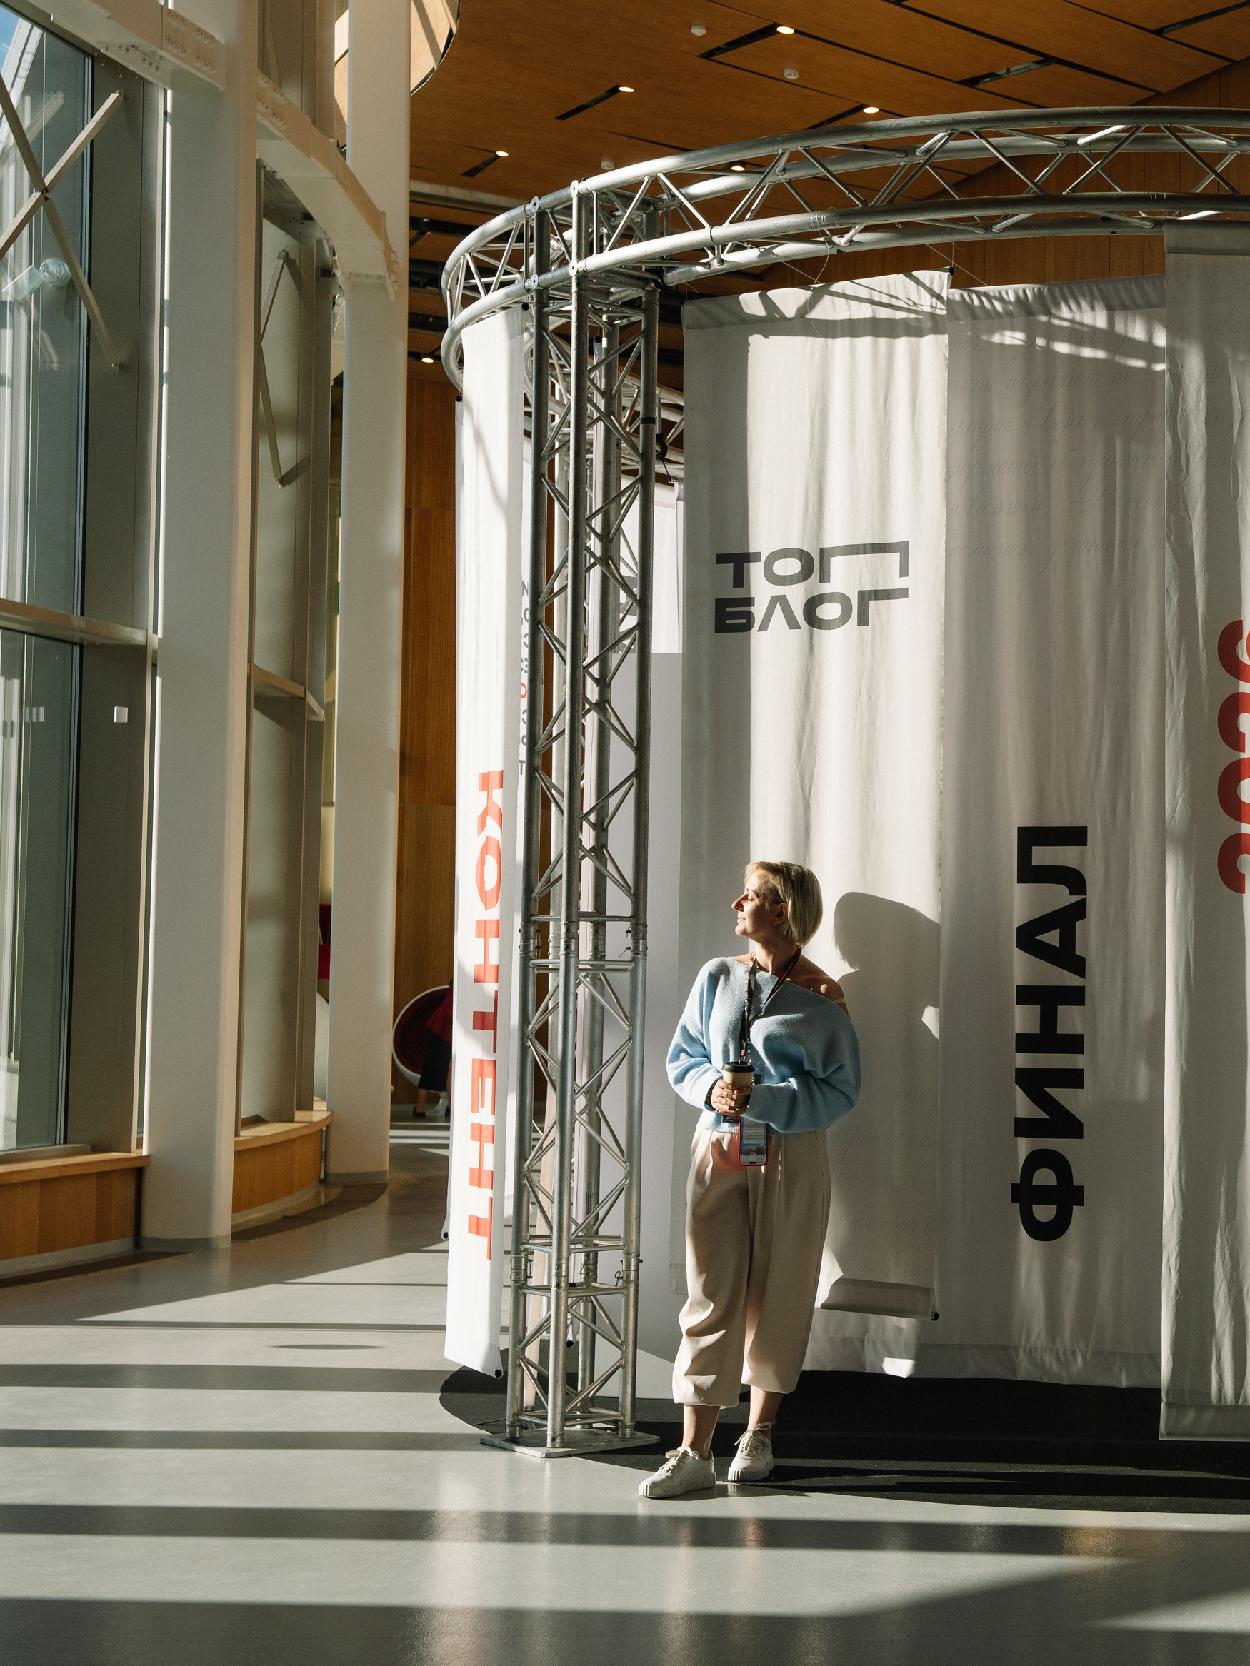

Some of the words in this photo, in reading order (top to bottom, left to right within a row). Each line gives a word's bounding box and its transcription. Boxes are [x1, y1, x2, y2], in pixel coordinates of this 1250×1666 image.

[714, 587, 910, 633] БЛОГ
[715, 541, 910, 588] ТОП
[466, 770, 504, 1261] КОНТЕНТ
[1010, 825, 1089, 1242] ФИНАЛ
